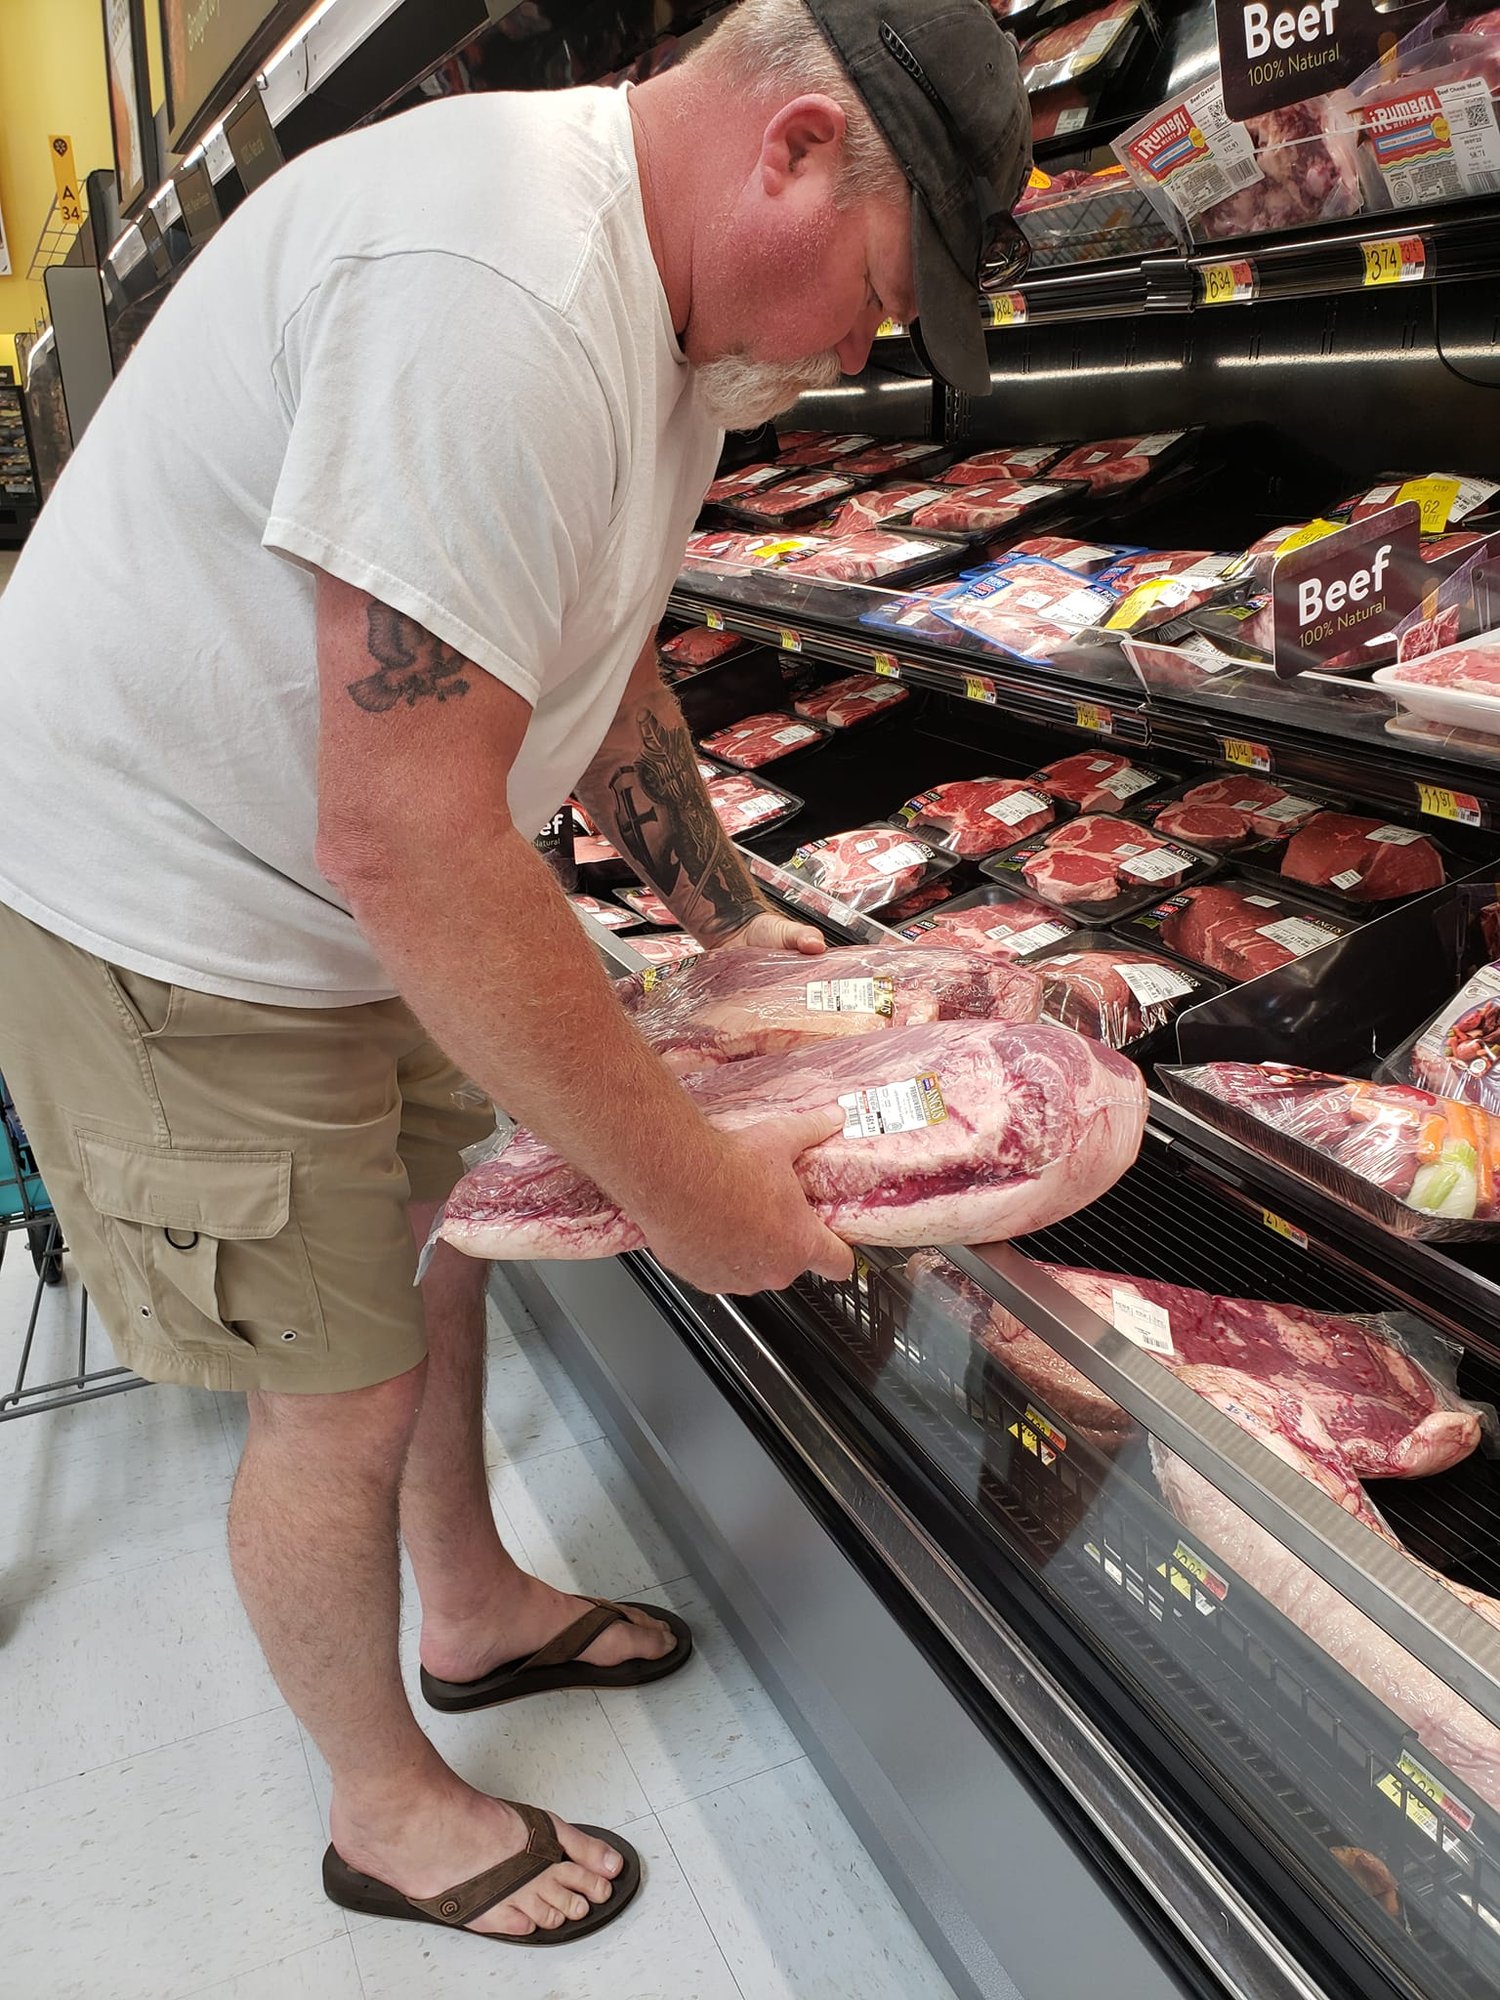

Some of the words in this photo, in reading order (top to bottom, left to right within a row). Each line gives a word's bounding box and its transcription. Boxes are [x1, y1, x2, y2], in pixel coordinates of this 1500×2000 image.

[1243, 0, 1340, 59] Beef
[1248, 59, 1284, 87] 100%
[1288, 42, 1340, 74] Natural
[63, 185, 75, 200] A
[62, 206, 80, 221] 34
[1298, 544, 1392, 627] Beef
[1299, 620, 1334, 649] 100%
[1337, 595, 1387, 632] Natural
[540, 813, 564, 836] ef
[926, 1088, 945, 1119] ANGUS
